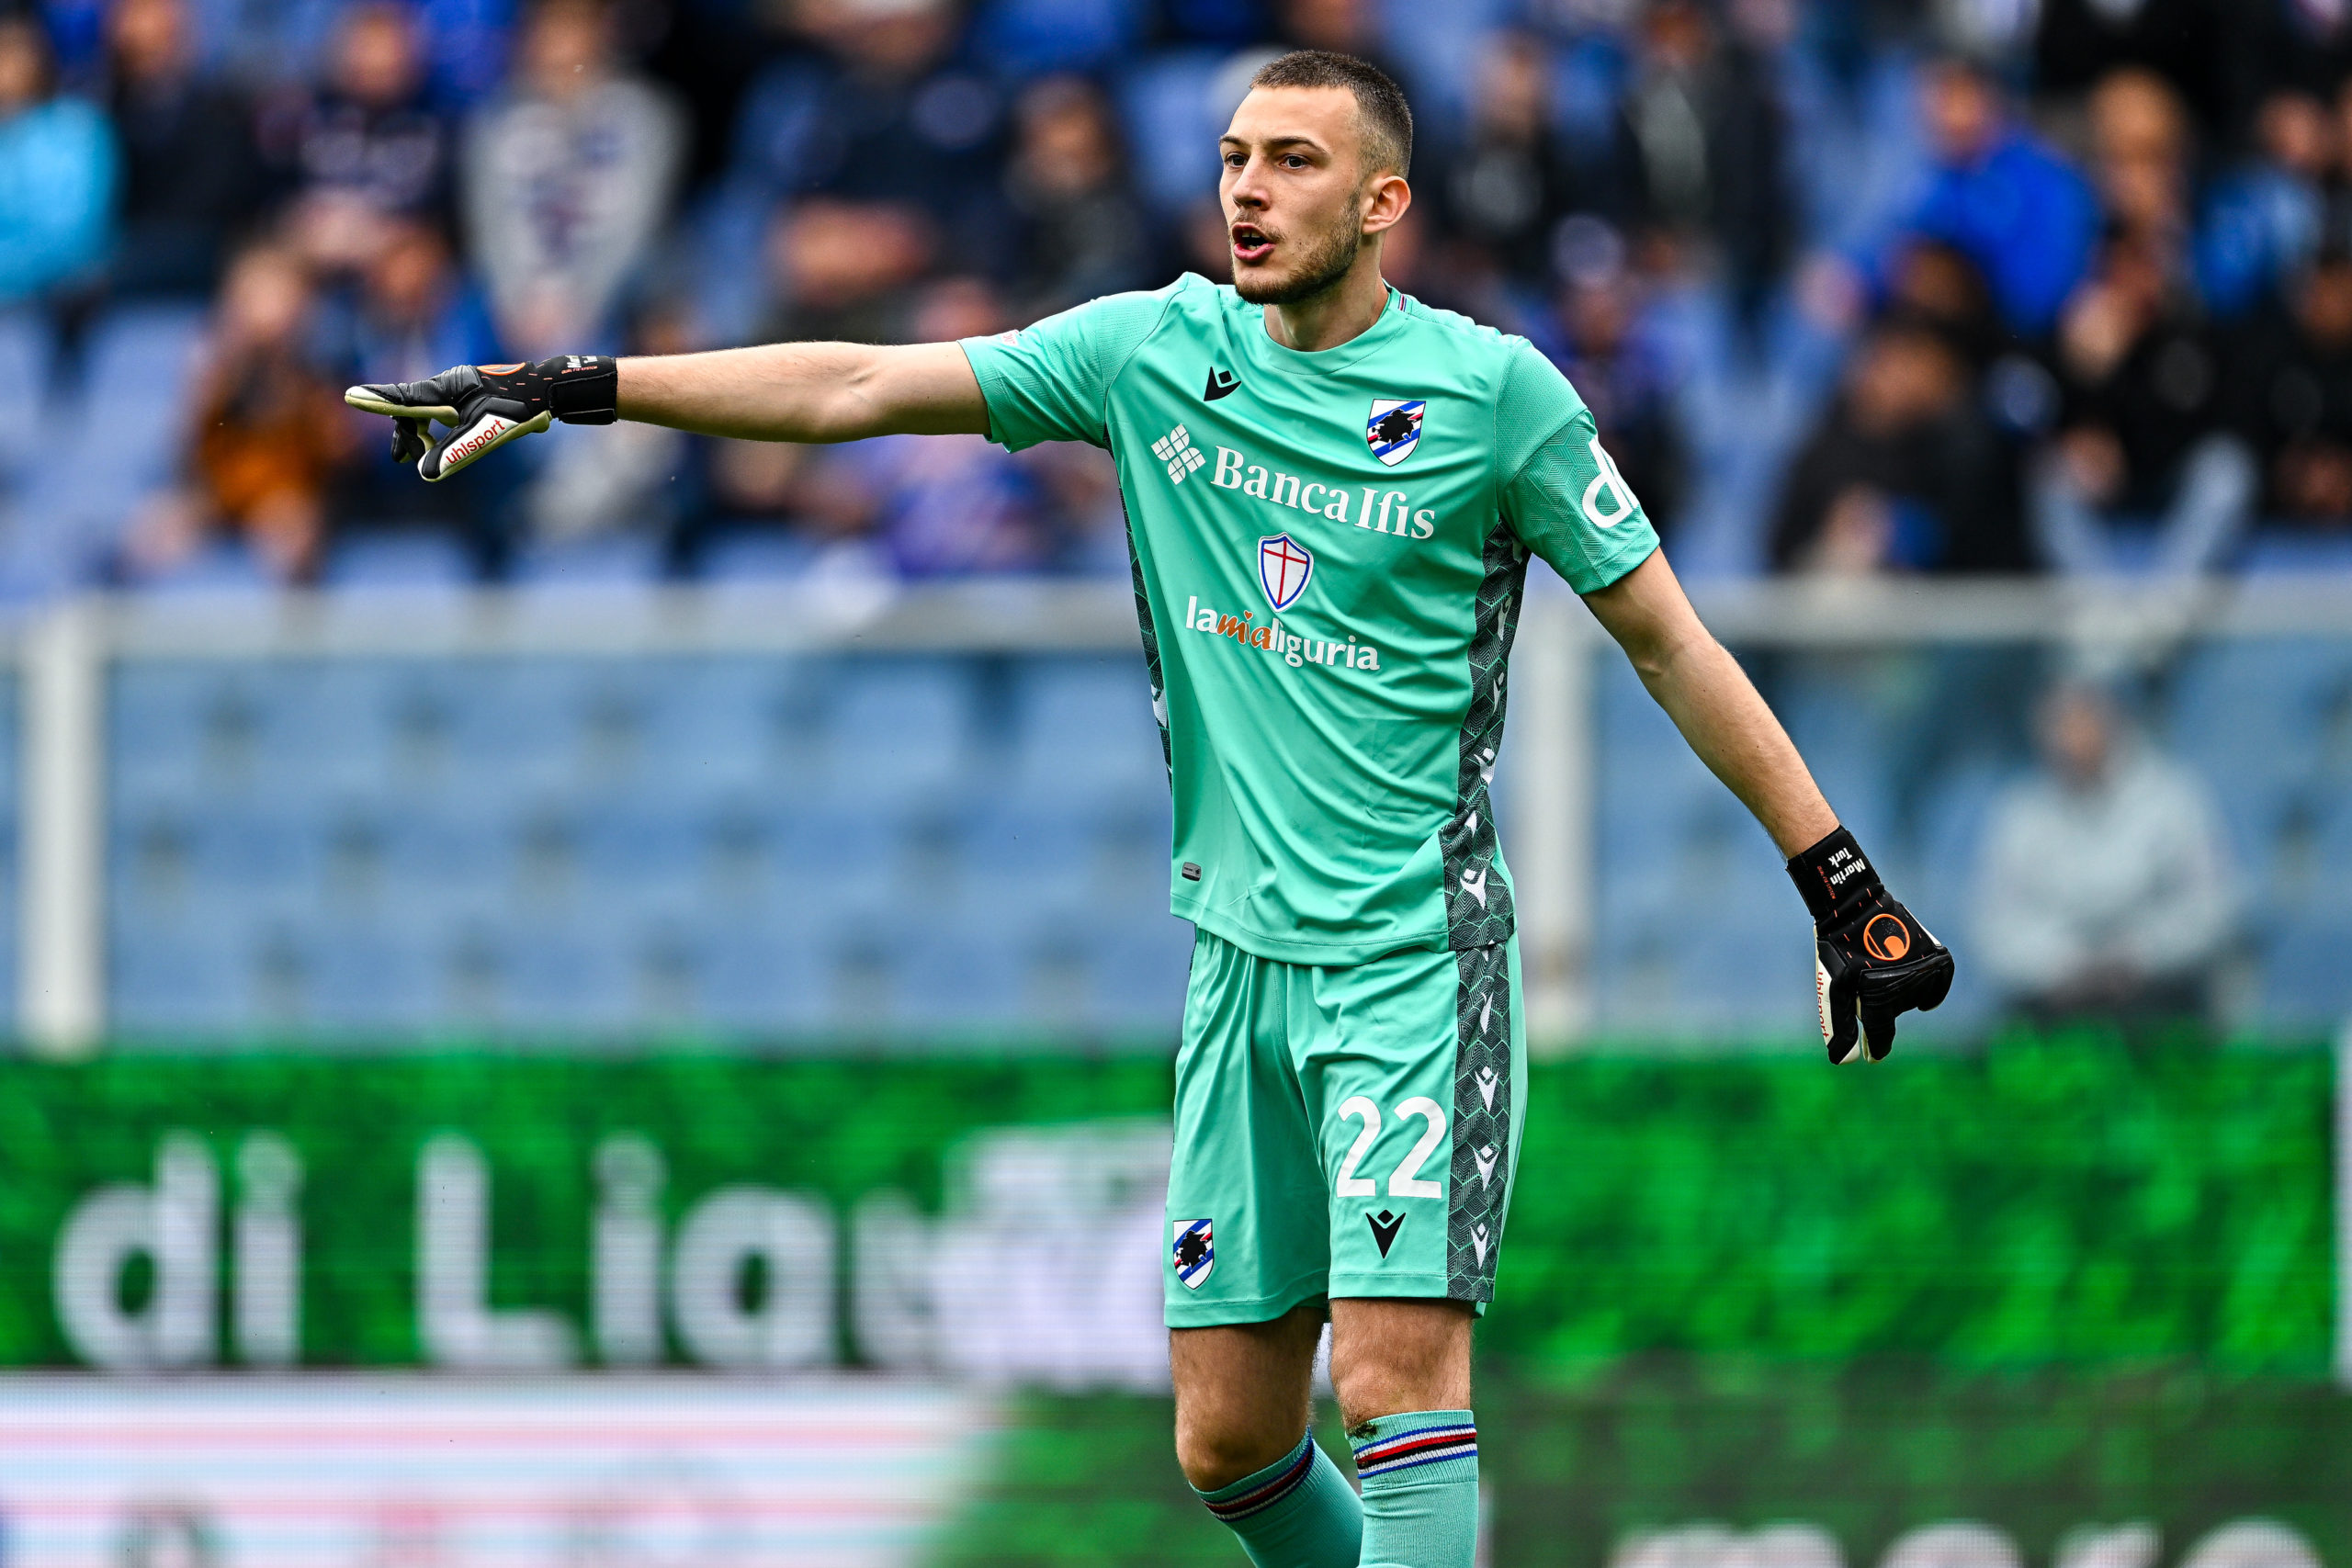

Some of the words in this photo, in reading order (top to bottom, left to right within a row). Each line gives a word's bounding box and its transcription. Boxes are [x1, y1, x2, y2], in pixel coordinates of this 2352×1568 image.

[446, 419, 506, 465] uhlsport
[1211, 446, 1349, 524] Banca
[1354, 487, 1435, 540] Ifis
[1827, 847, 1853, 868] Turk
[1829, 858, 1866, 886] Martin
[1336, 1095, 1447, 1200] 22
[53, 1130, 303, 1371] di
